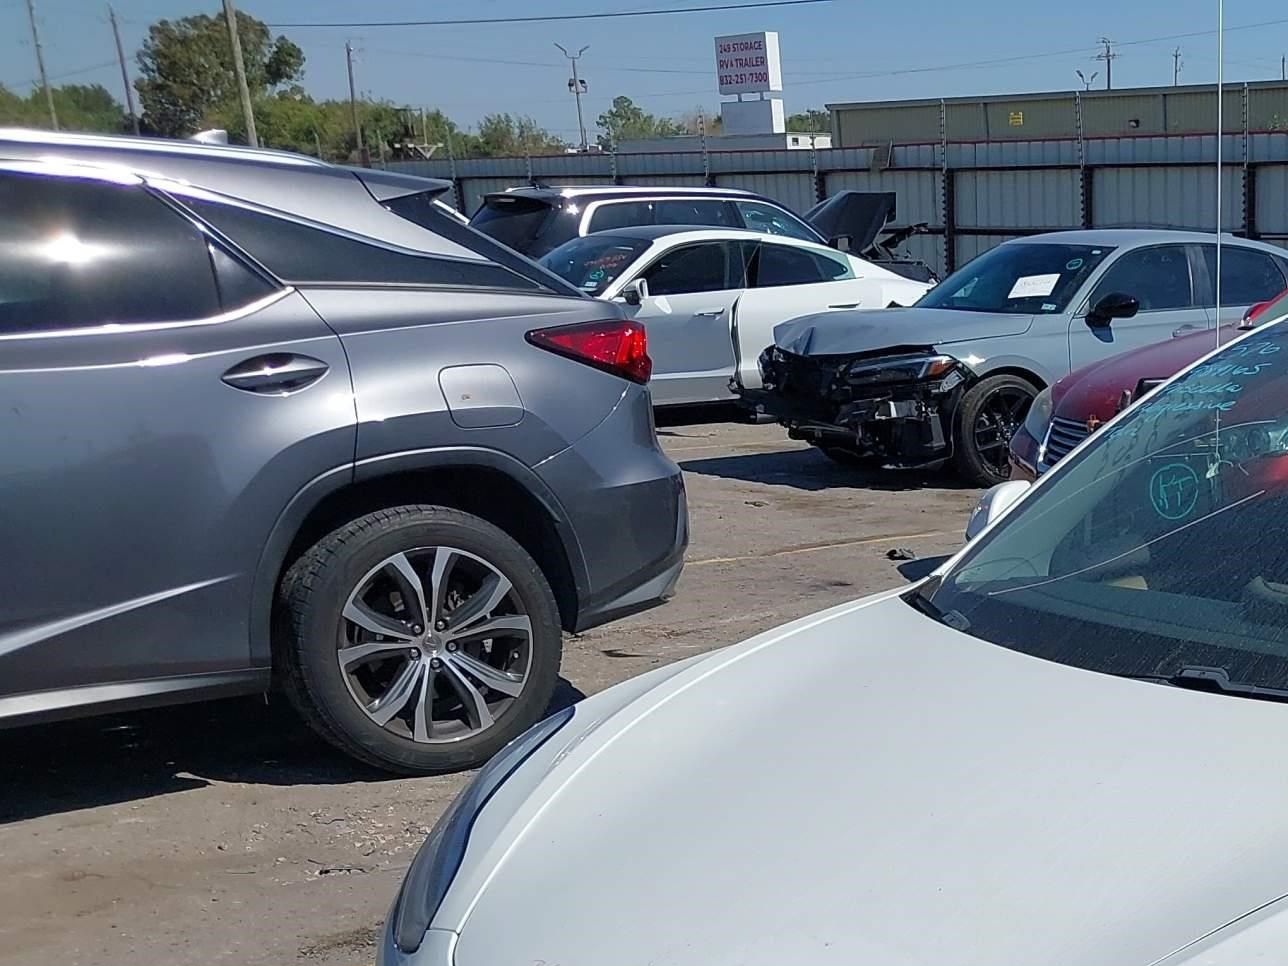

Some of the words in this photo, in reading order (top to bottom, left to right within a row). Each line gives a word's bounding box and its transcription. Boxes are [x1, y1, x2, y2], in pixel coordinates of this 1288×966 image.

[732, 41, 763, 52] STORAGE
[719, 59, 729, 70] RV
[735, 56, 765, 68] TRAILER
